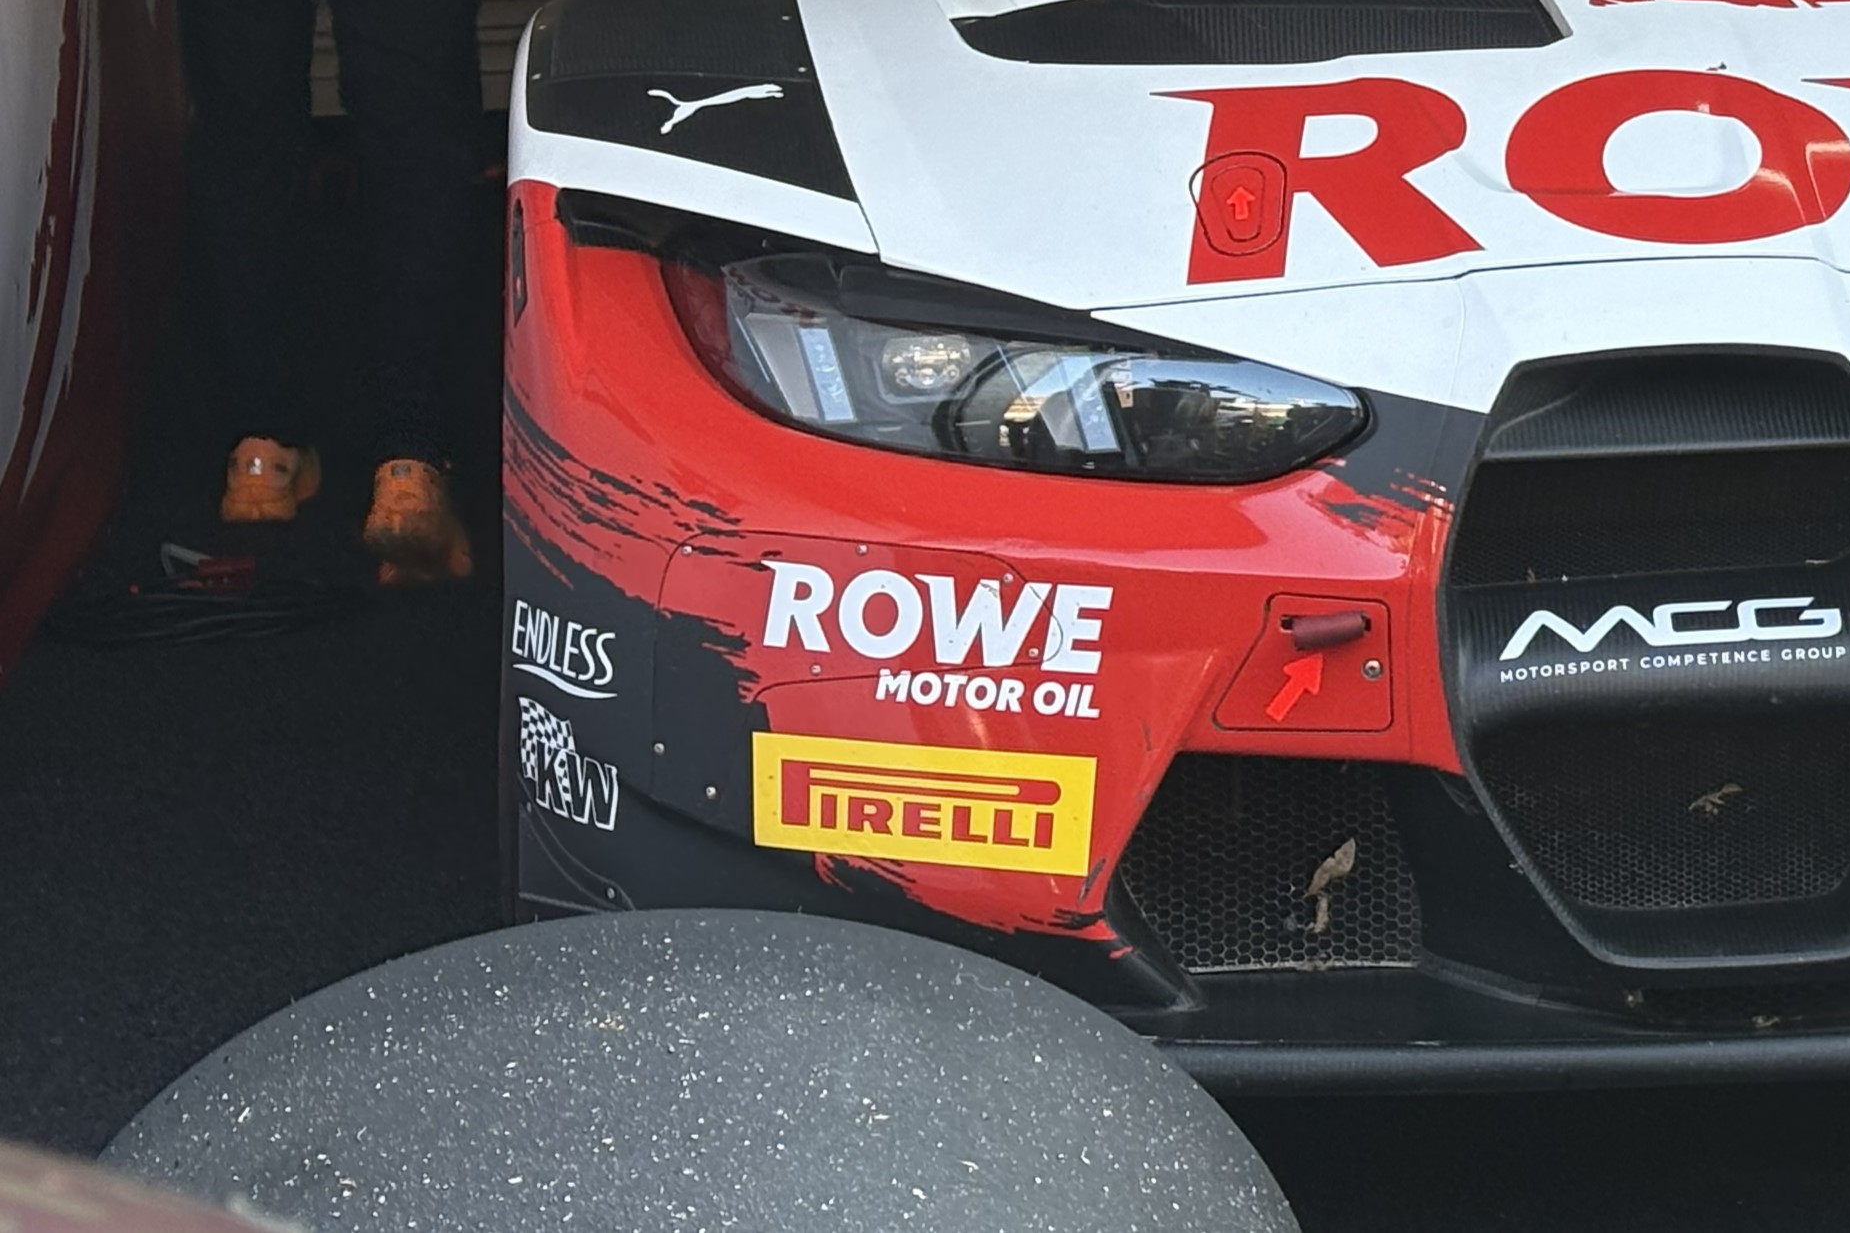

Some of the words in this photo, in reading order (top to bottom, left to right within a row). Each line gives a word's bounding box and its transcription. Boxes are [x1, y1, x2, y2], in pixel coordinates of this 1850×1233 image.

[512, 599, 616, 686] ENDLESS
[760, 560, 1113, 675] ROWE
[1499, 596, 1842, 661] MCG
[876, 668, 1021, 714] MOTOR
[1034, 680, 1100, 719] OIL
[1500, 657, 1631, 683] MOTORSPORT
[1640, 649, 1772, 670] COMPETENCE
[1781, 645, 1848, 662] GROUP
[535, 738, 619, 831] KW
[782, 759, 1061, 849] PIRELLI
